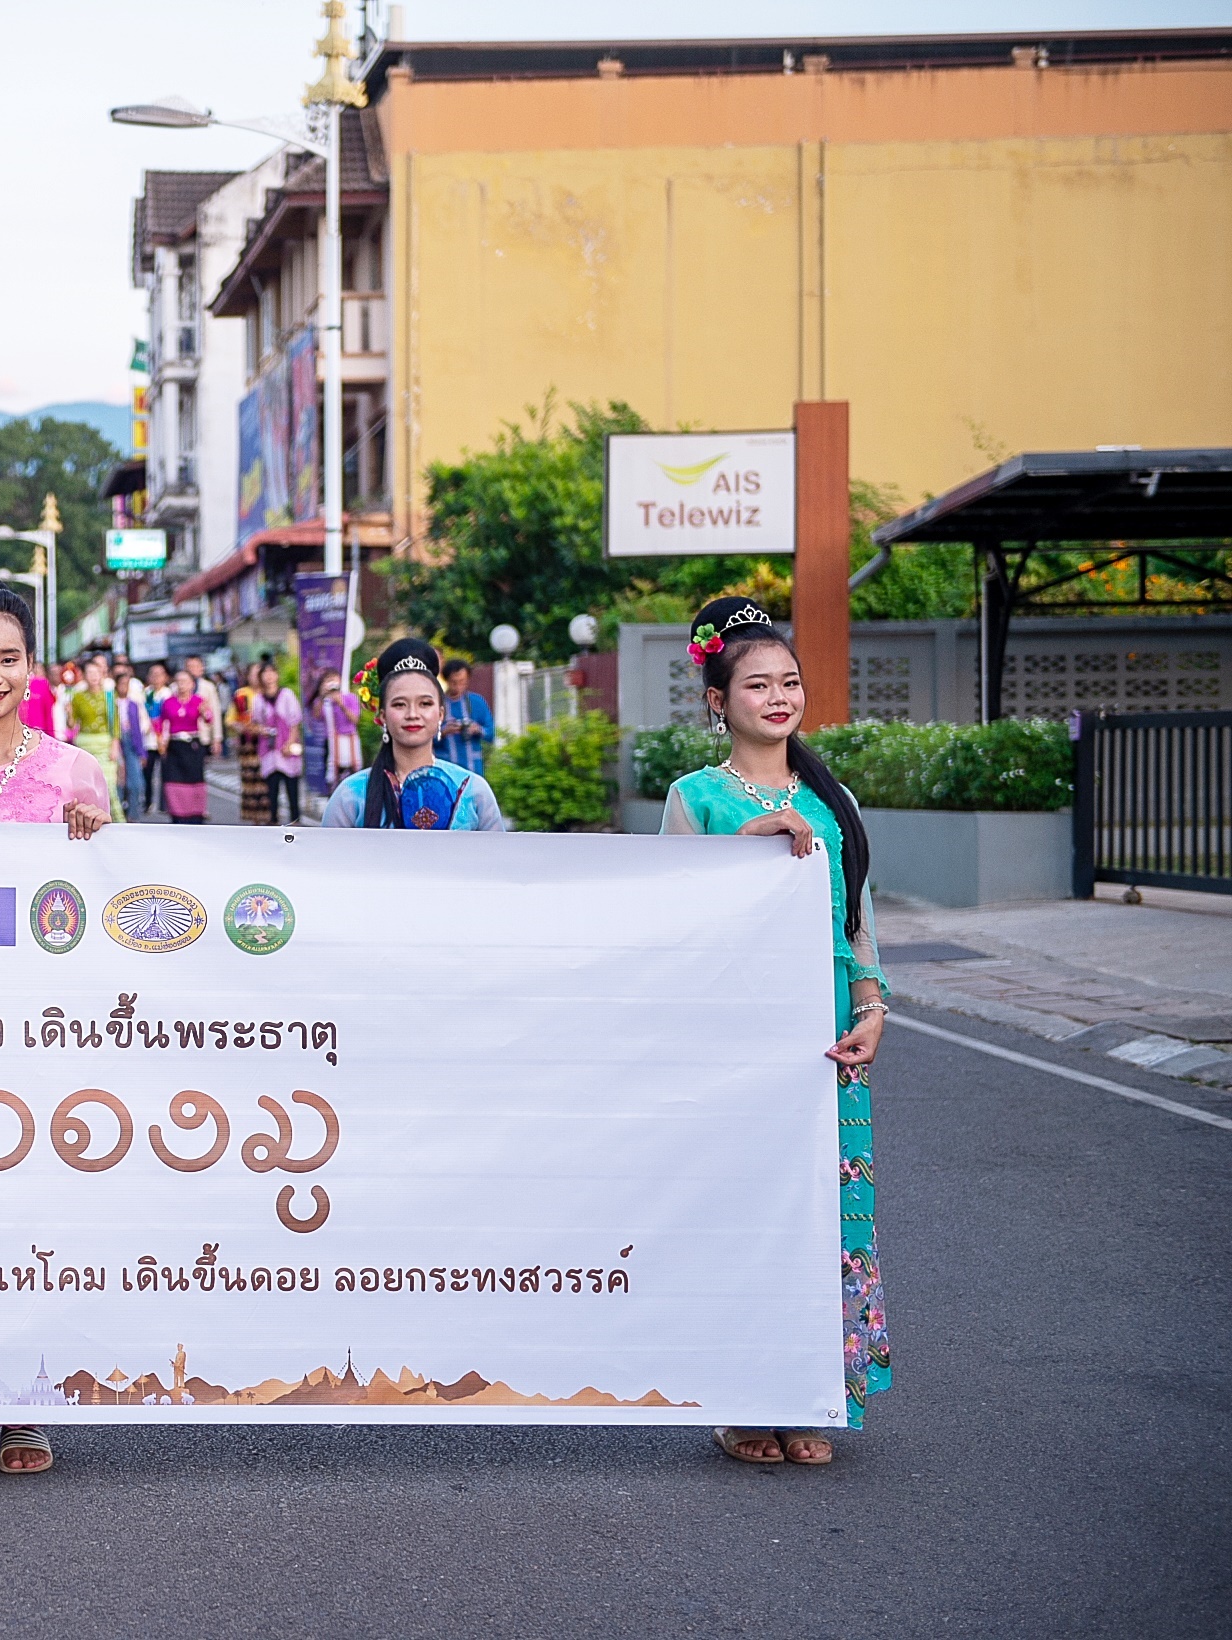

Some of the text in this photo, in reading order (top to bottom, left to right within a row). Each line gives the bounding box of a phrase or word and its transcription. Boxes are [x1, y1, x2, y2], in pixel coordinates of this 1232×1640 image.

[713, 470, 761, 494] AIS
[638, 501, 761, 528] Telewiz
[24, 992, 338, 1067] เดินขึ้นพระธาตุ
[122, 1242, 320, 1292] เดินขึ้นดอย
[334, 1244, 634, 1294] ลอยกระทงสวรรค์
